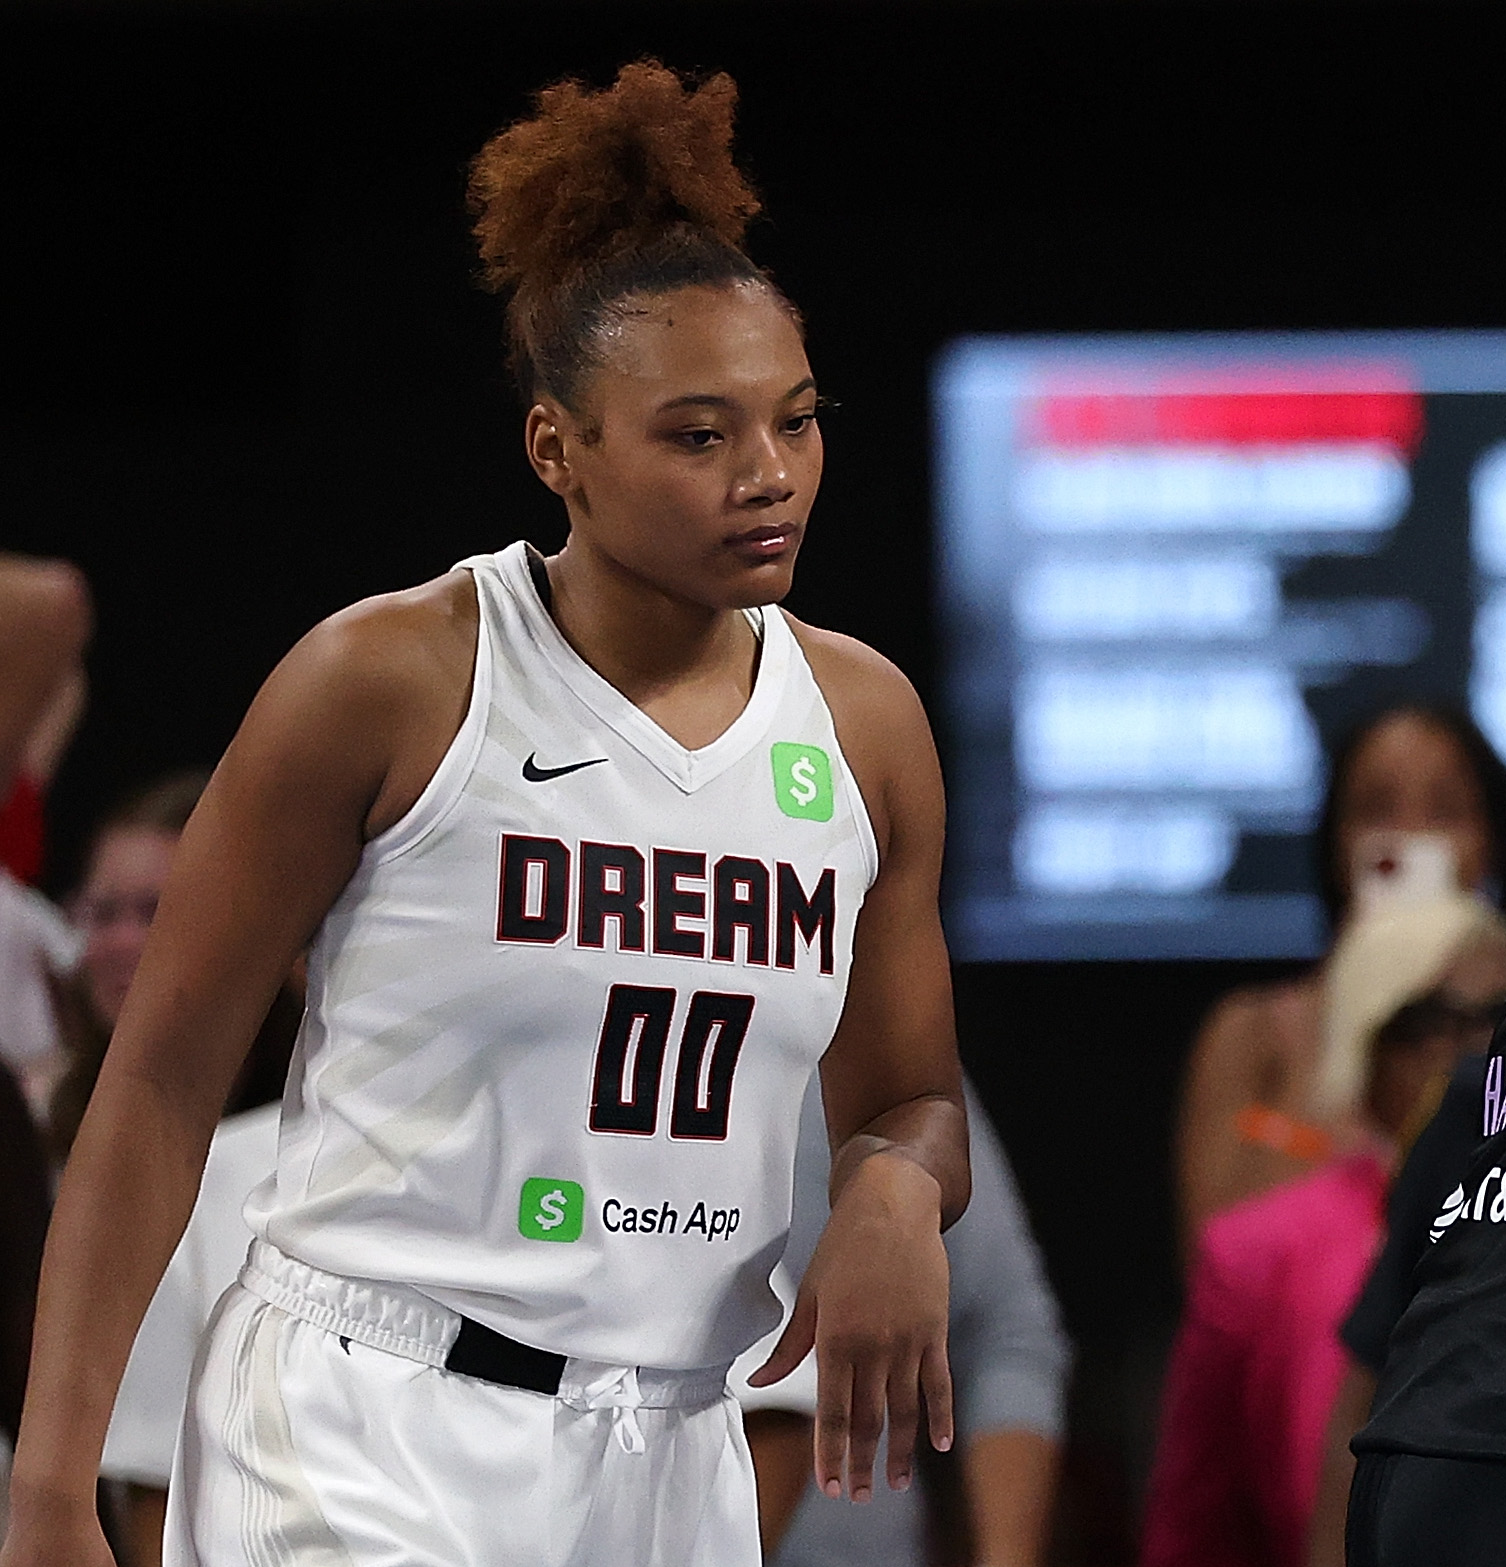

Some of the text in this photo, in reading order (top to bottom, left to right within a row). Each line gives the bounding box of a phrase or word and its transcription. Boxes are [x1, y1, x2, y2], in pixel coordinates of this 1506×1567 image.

[496, 833, 836, 976] DREAM
[588, 983, 757, 1141] 00
[602, 1198, 678, 1234] Cash
[682, 1201, 740, 1243] App
